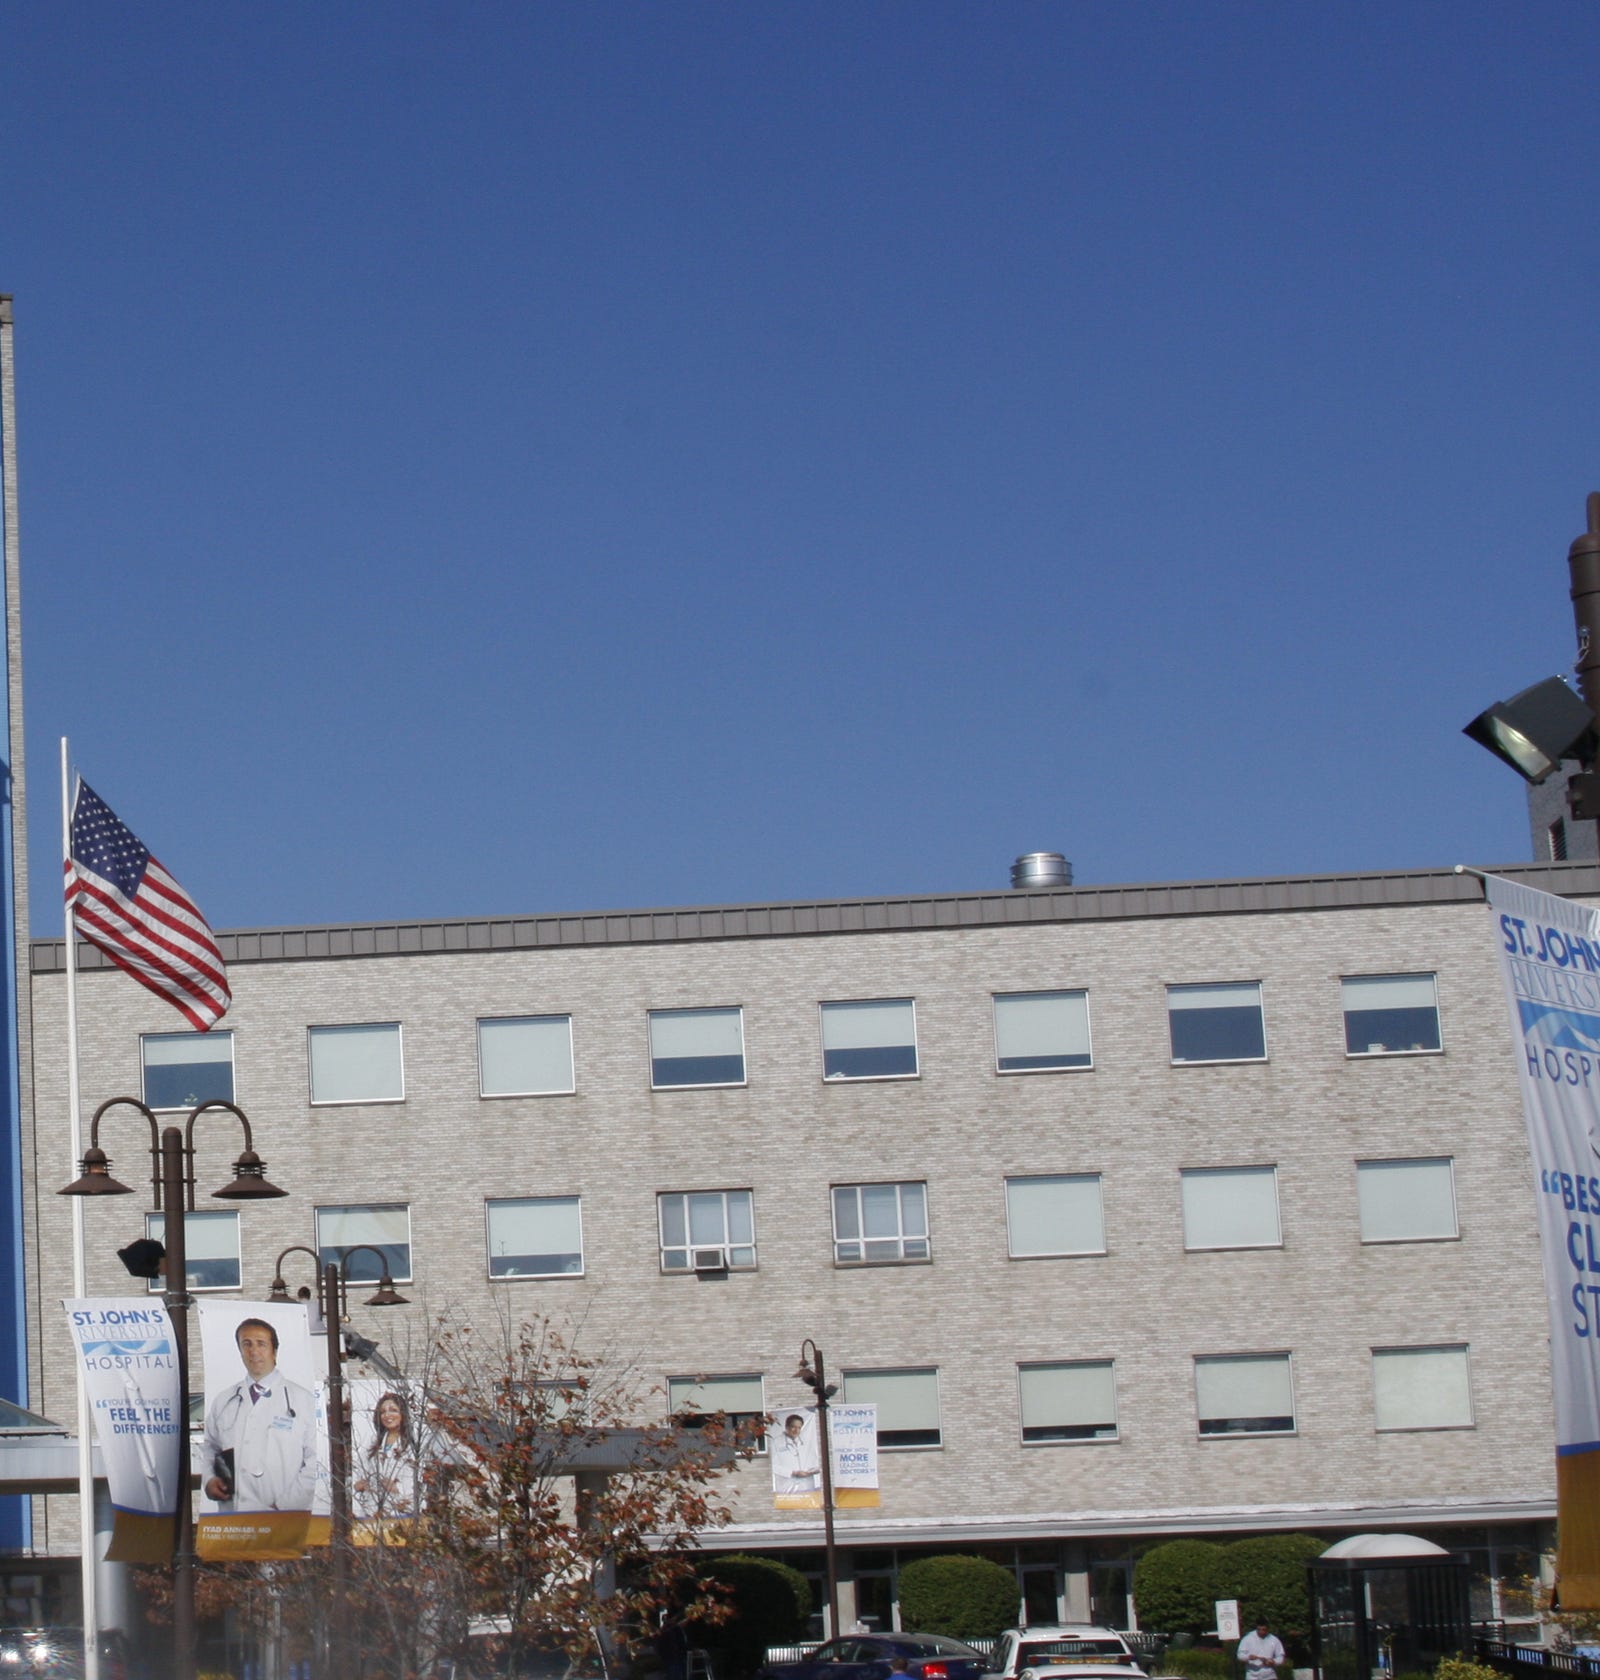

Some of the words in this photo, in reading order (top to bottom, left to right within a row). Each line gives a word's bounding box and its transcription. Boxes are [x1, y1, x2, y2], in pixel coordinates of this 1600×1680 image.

[1500, 914, 1532, 957] ST.
[73, 1311, 95, 1326] ST.
[100, 1310, 163, 1325] JOHN'S
[78, 1325, 168, 1340] RIVERSIDE
[85, 1355, 173, 1370] HOSPITAL
[110, 1408, 140, 1421] FEEL
[144, 1408, 171, 1421] THE
[843, 1409, 874, 1417] JOHN'S
[840, 1454, 869, 1462] MORE
